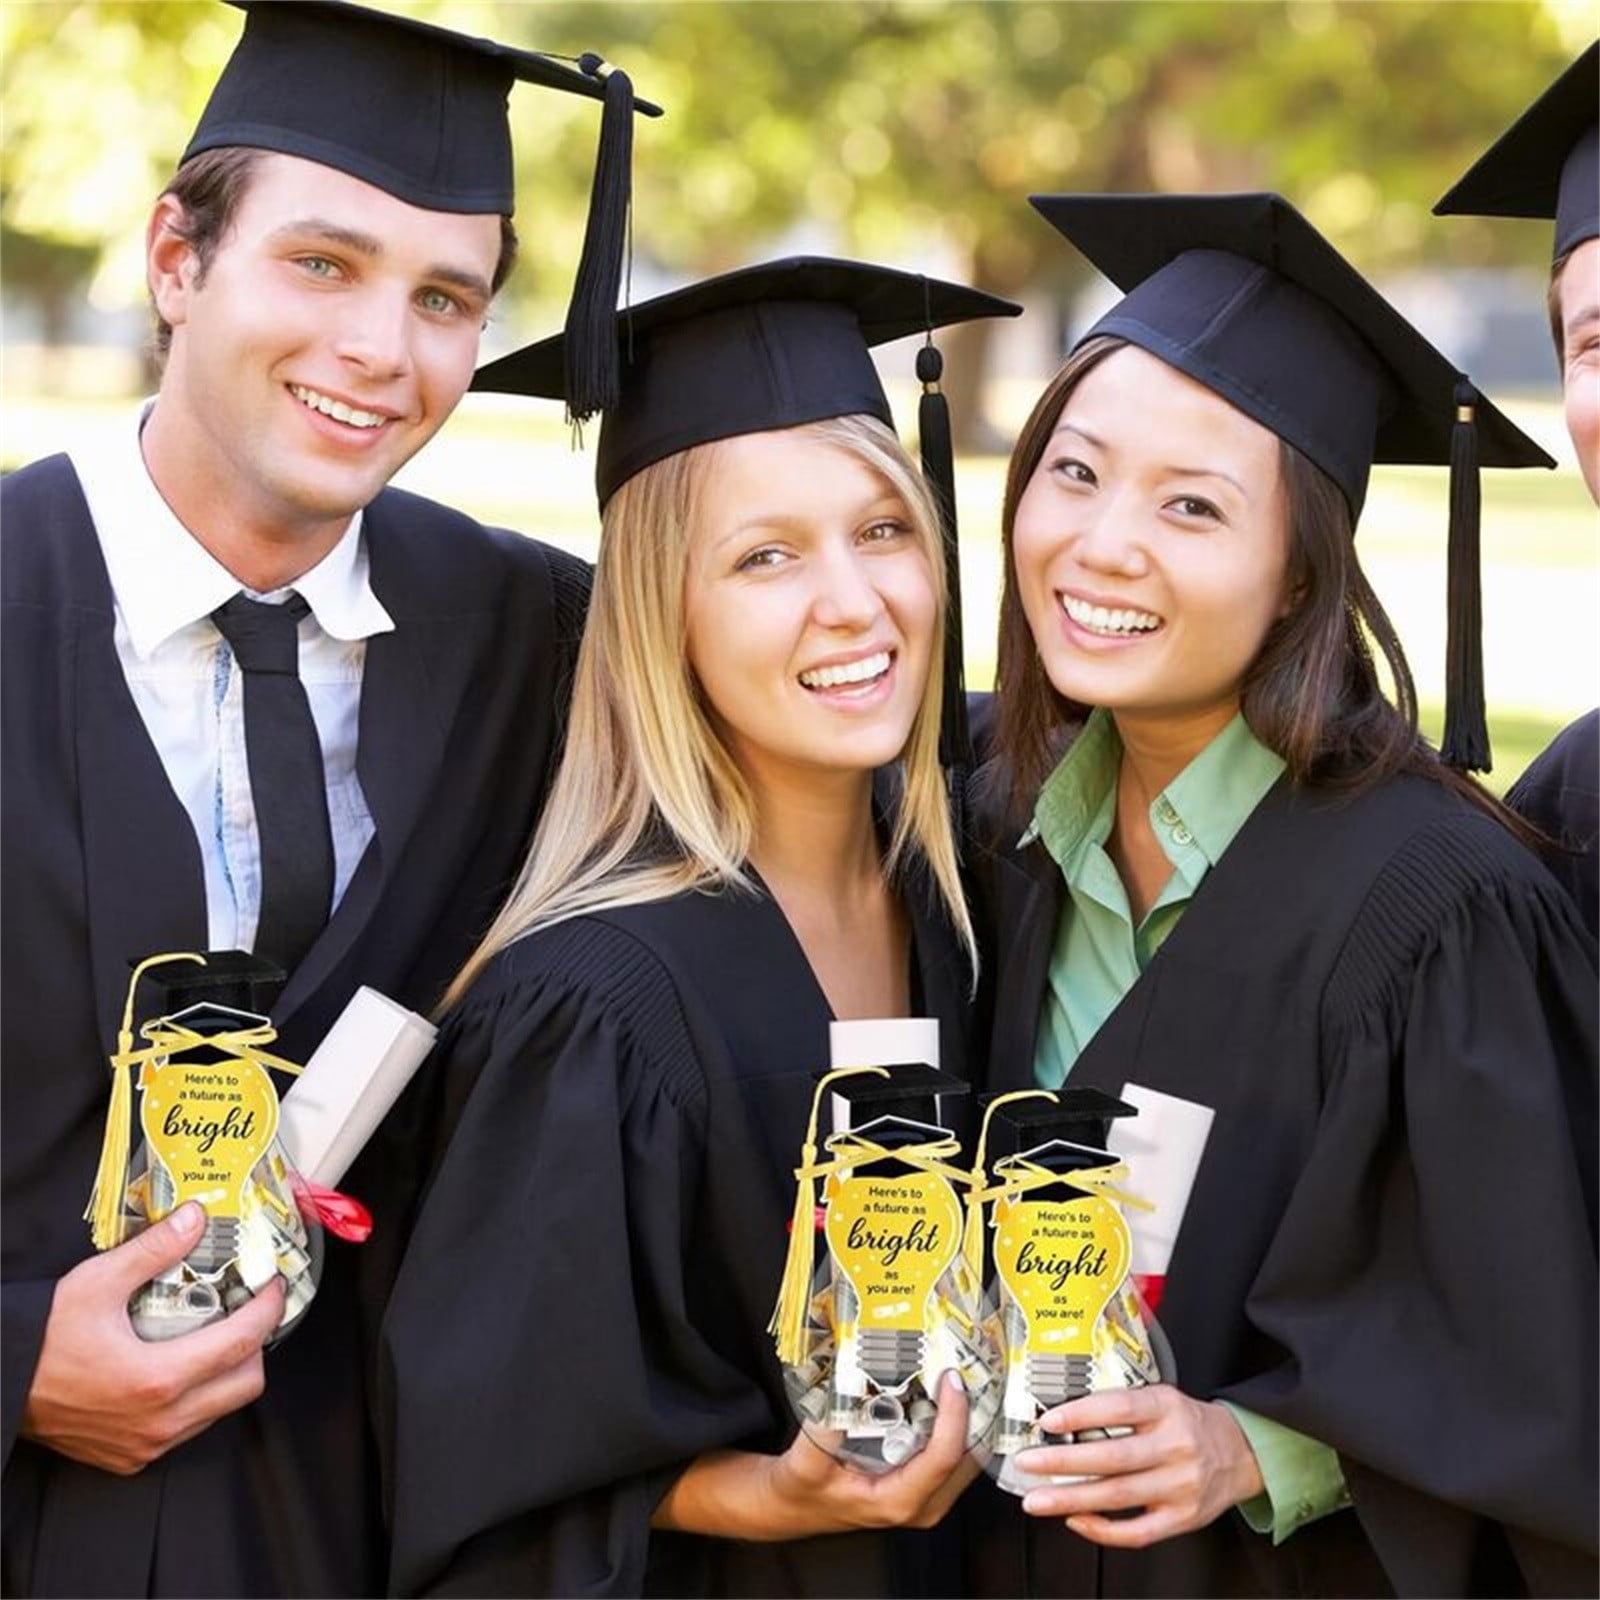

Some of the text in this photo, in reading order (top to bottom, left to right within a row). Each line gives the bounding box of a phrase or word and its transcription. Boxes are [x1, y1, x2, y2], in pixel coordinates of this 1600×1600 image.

[185, 1073, 239, 1086] Here's to
[179, 1089, 242, 1102] a future as
[162, 1103, 255, 1154] bright
[201, 1158, 215, 1167] as
[183, 1171, 231, 1182] you are!
[868, 1186, 923, 1199] Here's to
[863, 1202, 926, 1215] a future as
[1037, 1210, 1091, 1224] Here's to
[1031, 1227, 1095, 1239] a future as
[847, 1216, 939, 1267] bright
[1015, 1241, 1108, 1292] bright
[884, 1271, 899, 1280] as
[866, 1284, 915, 1296] you are!
[1053, 1296, 1067, 1305] as
[1035, 1308, 1084, 1321] you are!
